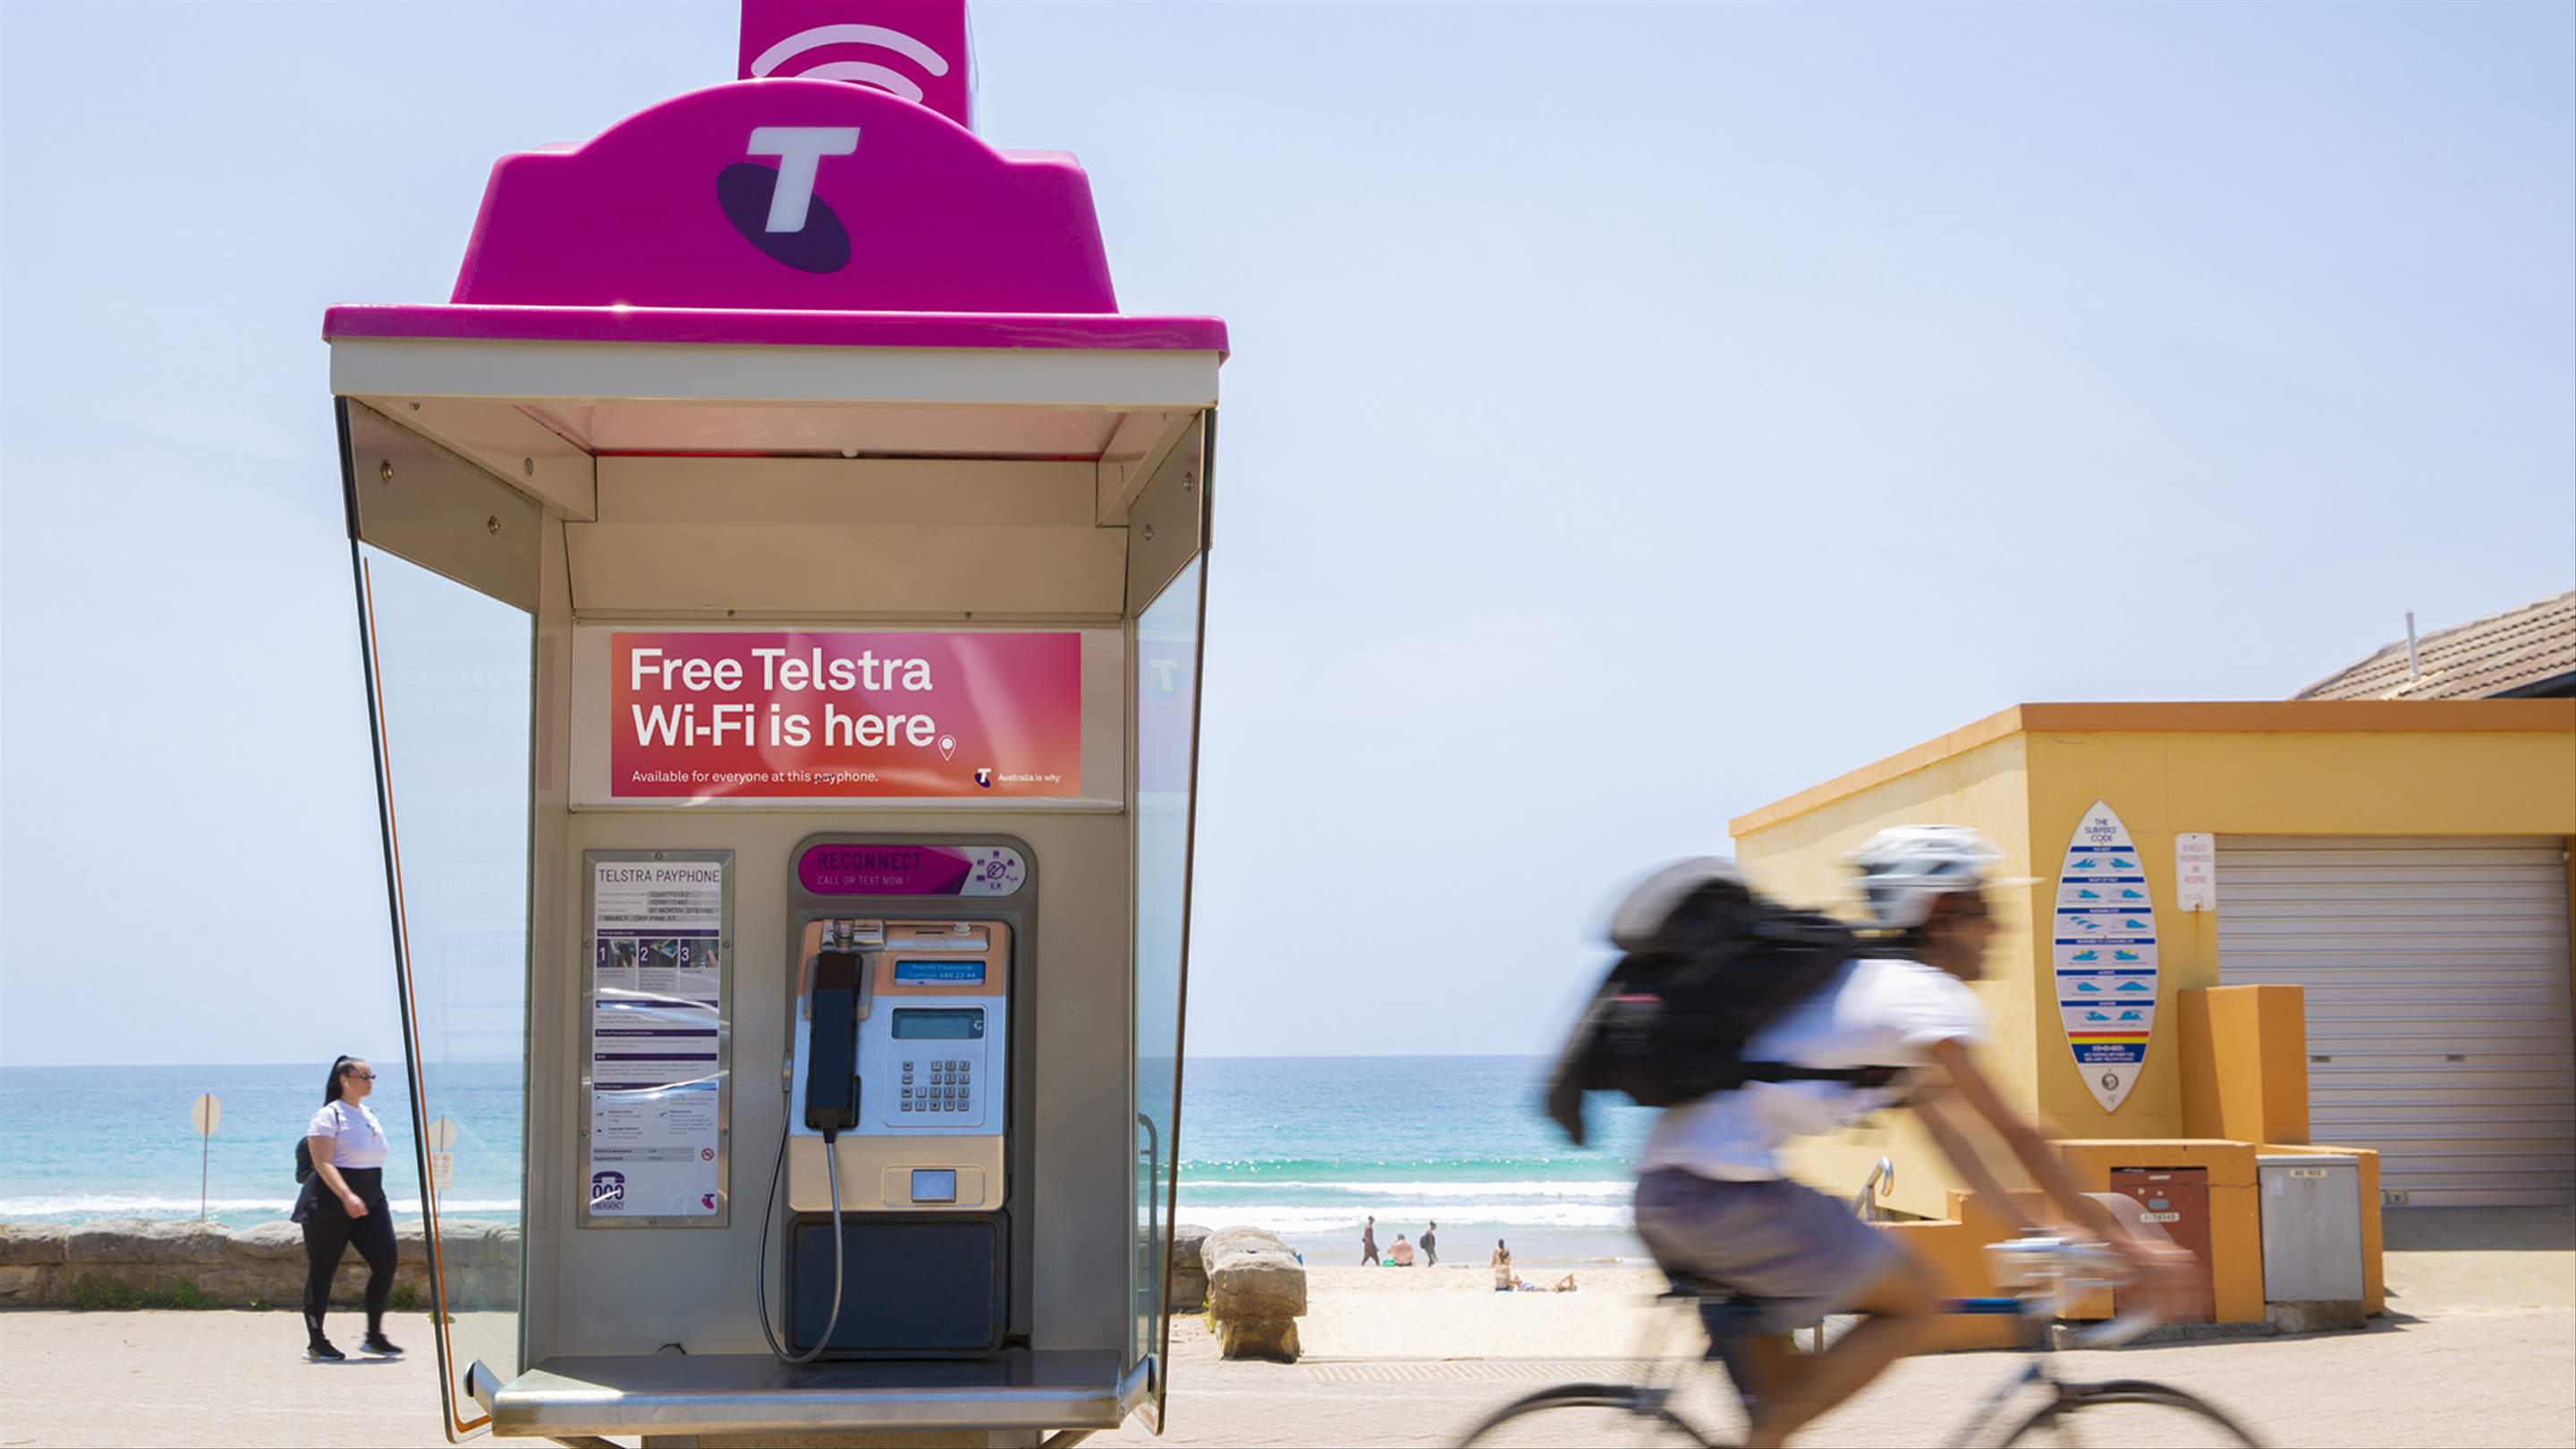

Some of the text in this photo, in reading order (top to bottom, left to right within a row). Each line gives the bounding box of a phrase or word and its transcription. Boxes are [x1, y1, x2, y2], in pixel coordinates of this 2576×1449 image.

[746, 126, 860, 233] T
[631, 648, 933, 691] Free Telstra
[631, 703, 754, 747] Wi-Fi
[770, 703, 812, 747] is
[631, 770, 878, 785] Available for everyone at this payphone.
[997, 774, 1061, 784] Australia is why
[599, 869, 720, 883] TELSTRA PAYPHONE
[818, 876, 839, 886] CALL
[843, 876, 856, 886] OR
[859, 876, 879, 886] TEXT
[882, 876, 903, 886] NOW
[599, 947, 606, 961] 1
[640, 947, 648, 961] 2
[681, 947, 689, 961] 3
[592, 1184, 624, 1200] 000
